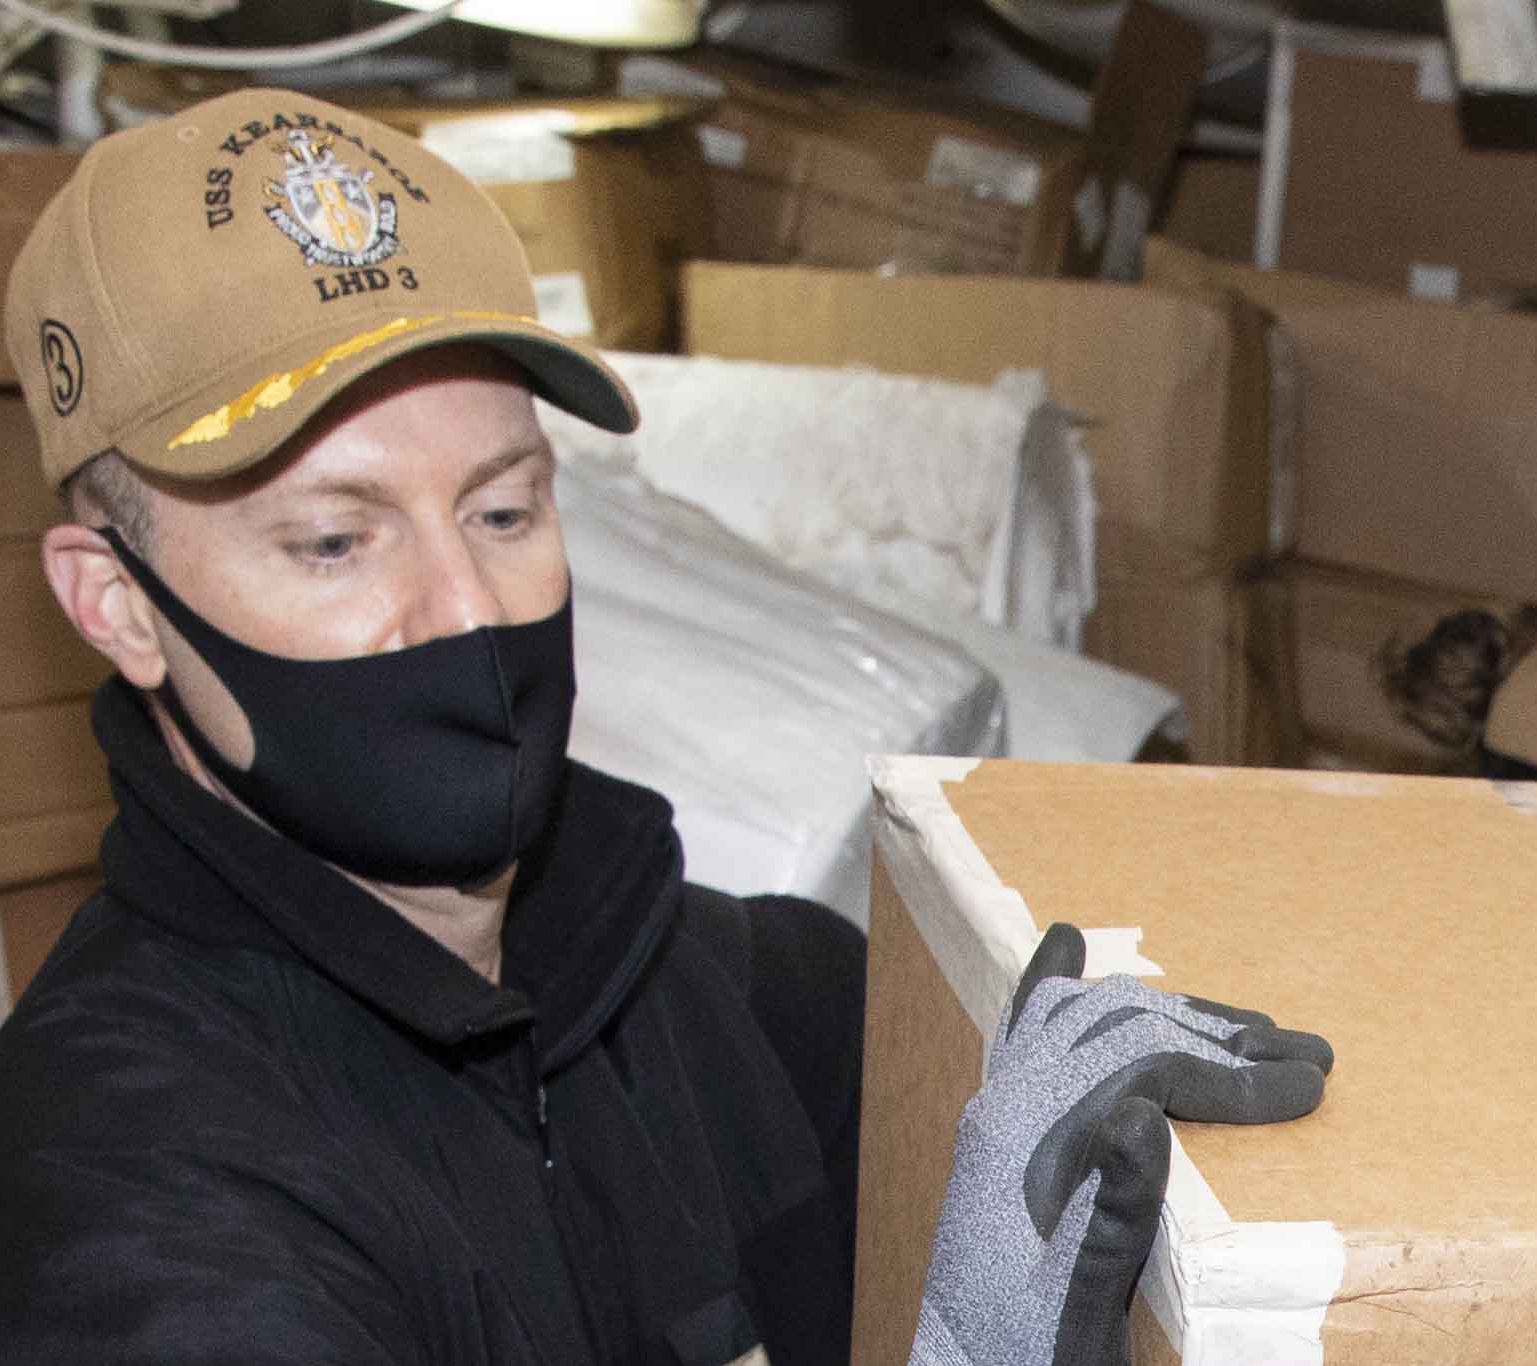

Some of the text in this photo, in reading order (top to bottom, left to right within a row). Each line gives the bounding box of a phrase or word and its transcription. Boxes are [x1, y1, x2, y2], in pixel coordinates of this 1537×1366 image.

[206, 167, 233, 228] USS
[314, 267, 418, 302] LHD 3
[47, 336, 73, 396] 3
